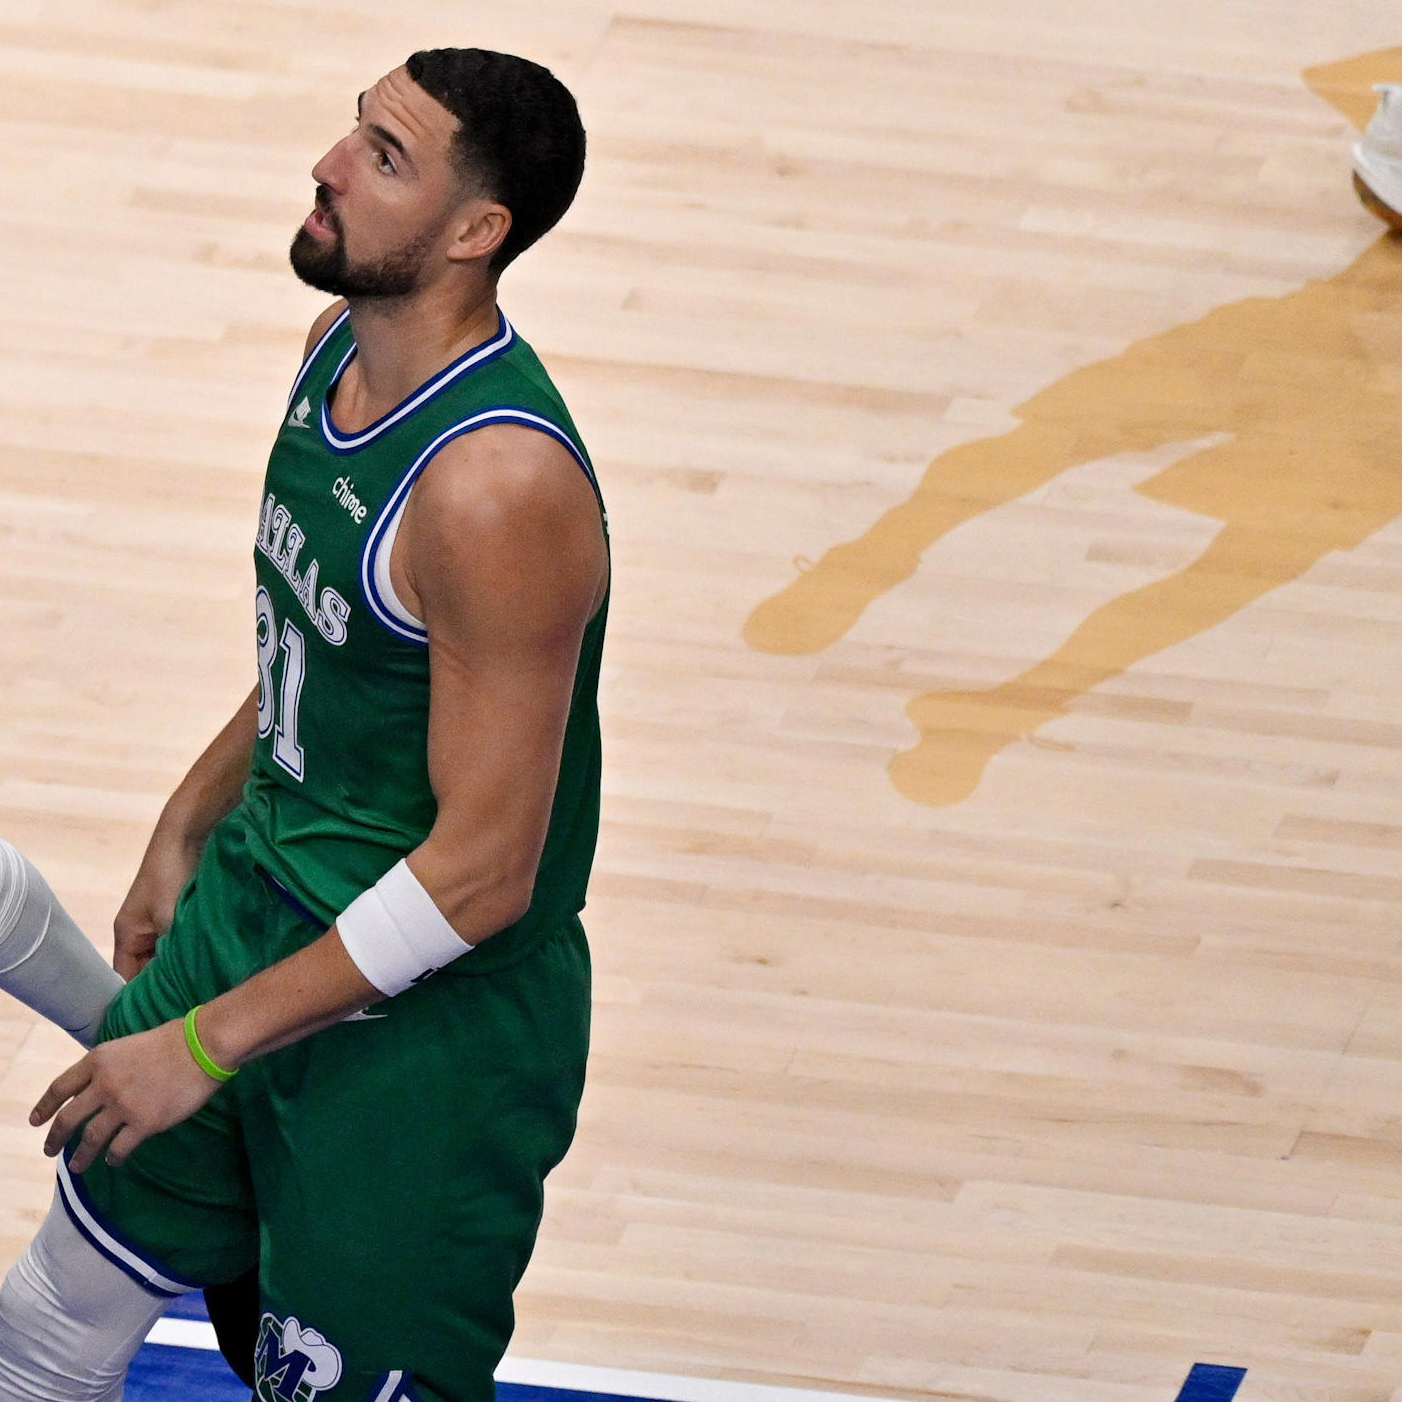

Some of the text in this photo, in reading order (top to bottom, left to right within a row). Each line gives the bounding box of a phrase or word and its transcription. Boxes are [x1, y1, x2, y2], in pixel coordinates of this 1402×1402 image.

[255, 493, 352, 647] ALLAS
[332, 476, 368, 525] chime
[256, 585, 306, 783] 31
